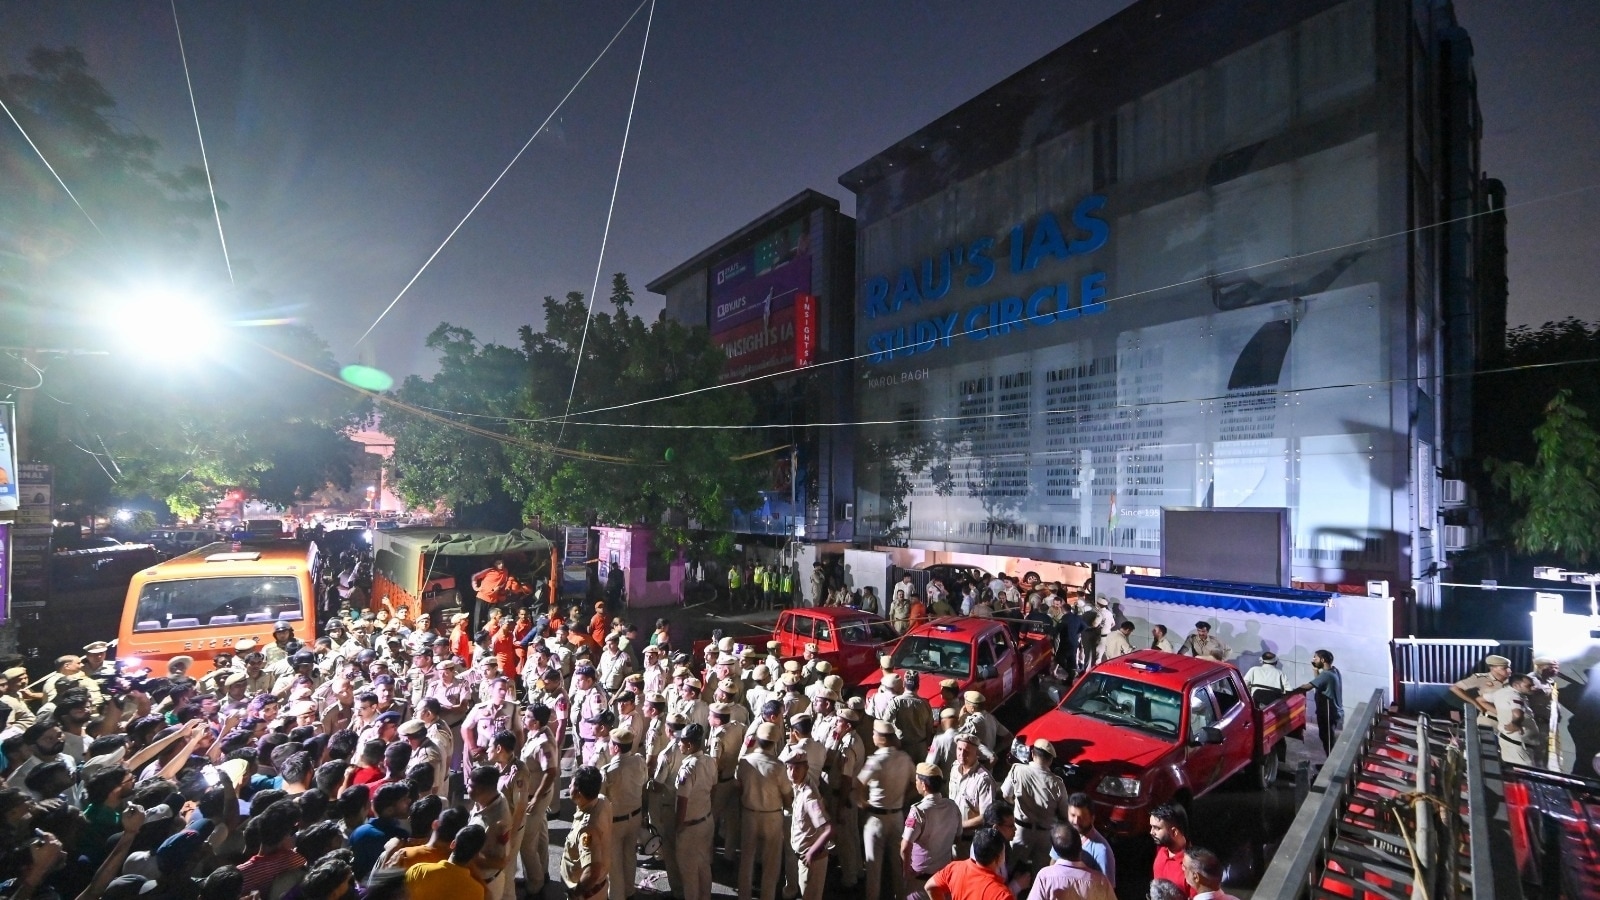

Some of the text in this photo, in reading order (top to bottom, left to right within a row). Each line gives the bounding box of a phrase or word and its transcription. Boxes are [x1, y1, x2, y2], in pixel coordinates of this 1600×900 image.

[1008, 194, 1110, 274] IAS
[724, 296, 746, 313] BYJU'S
[803, 296, 811, 357] INSIGHTS
[866, 272, 1106, 364] STUDY CIRCLE
[725, 326, 778, 358] INSIGHTS
[868, 368, 929, 389] KAROL BAGH
[1120, 508, 1141, 516] Since
[184, 636, 260, 651] EICHR
